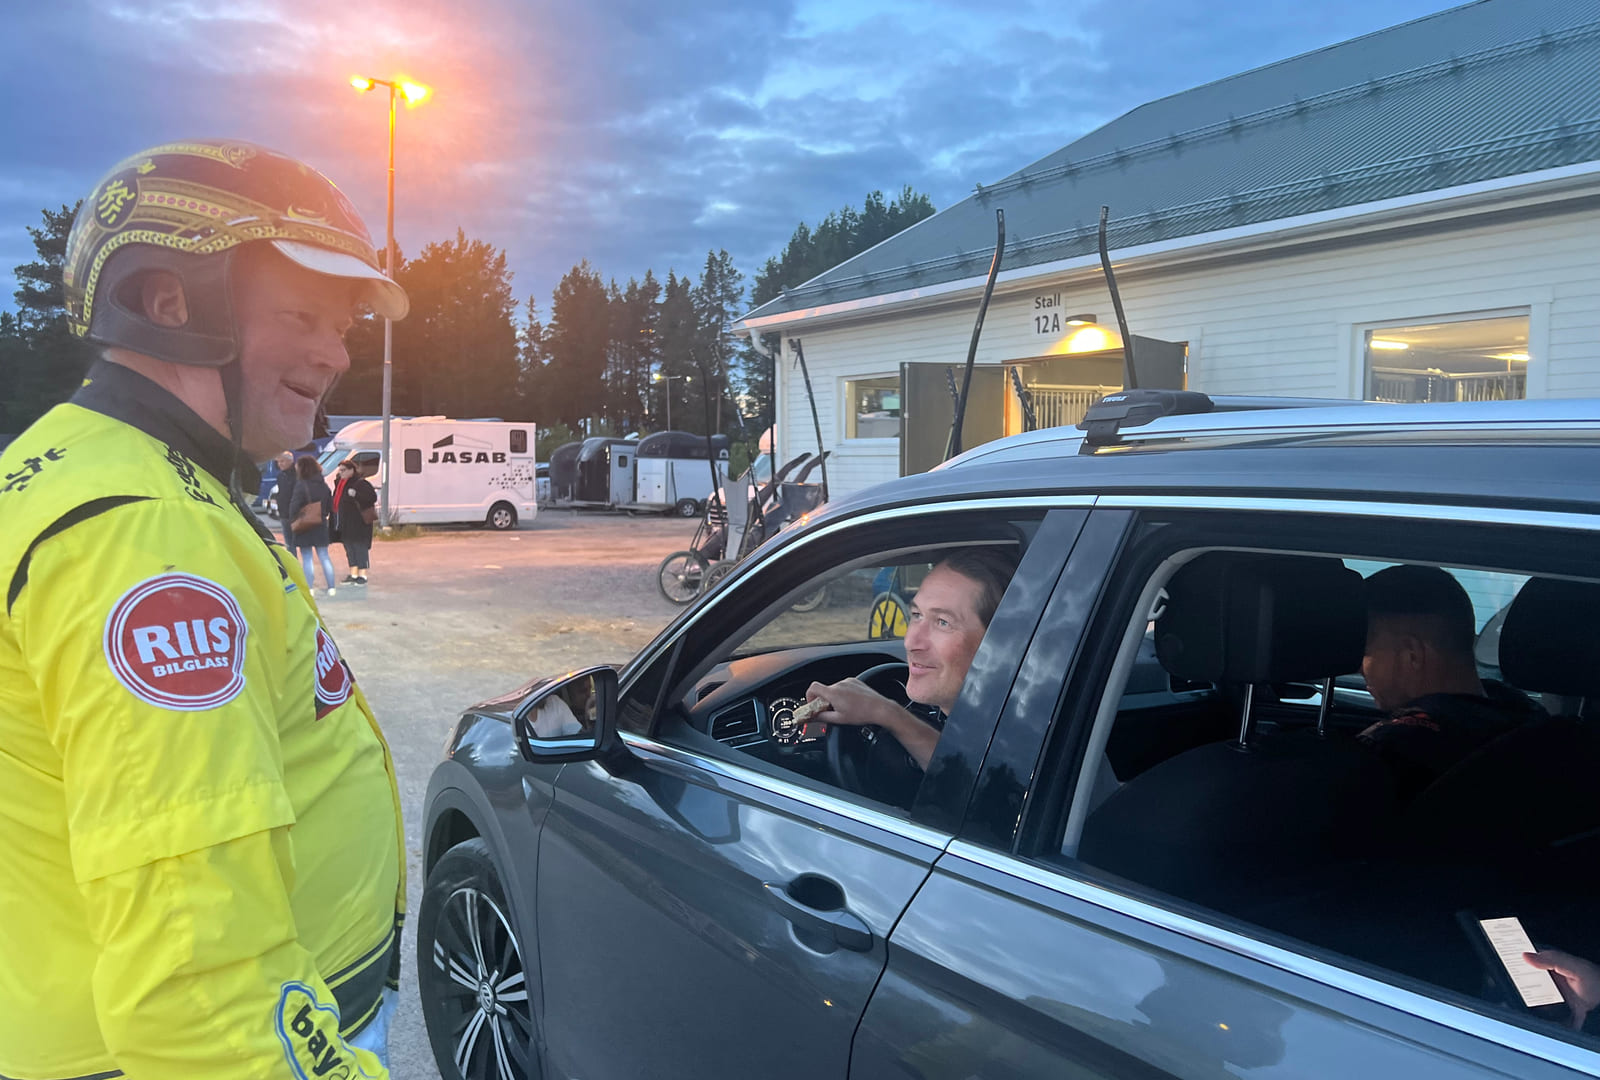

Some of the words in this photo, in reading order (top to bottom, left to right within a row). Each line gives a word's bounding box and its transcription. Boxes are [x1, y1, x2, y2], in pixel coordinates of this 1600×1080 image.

[1034, 293, 1061, 309] Stall
[1034, 313, 1061, 335] 12A
[428, 451, 506, 464] JASAB
[132, 617, 231, 664] RIIS
[152, 656, 230, 678] BILGLASS
[291, 1003, 343, 1077] bay
